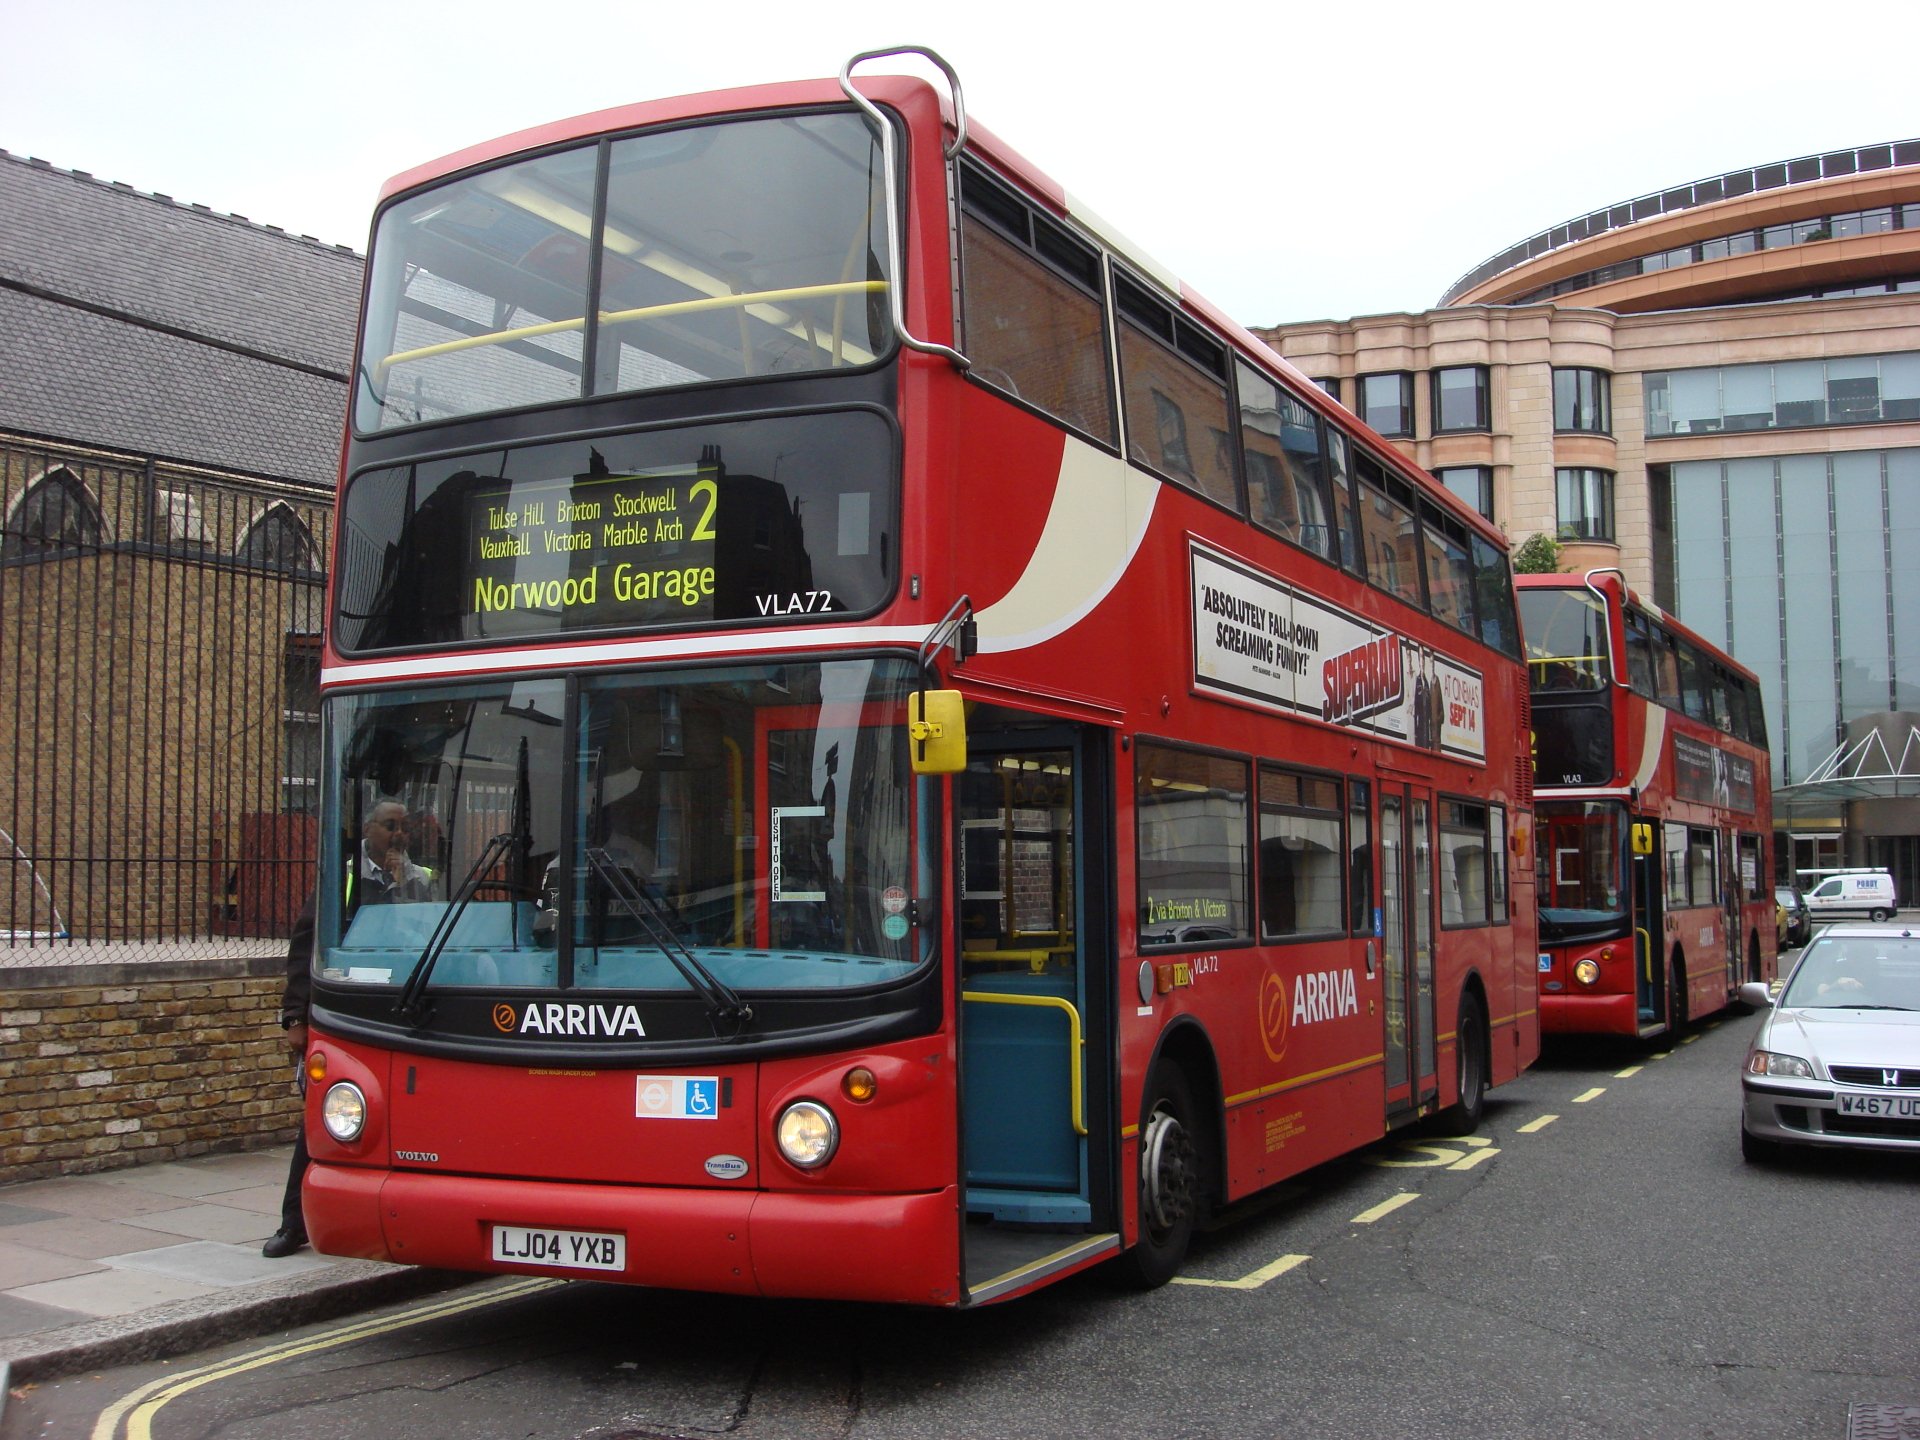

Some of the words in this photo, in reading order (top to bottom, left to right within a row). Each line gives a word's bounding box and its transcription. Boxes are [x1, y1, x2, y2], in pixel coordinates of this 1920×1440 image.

[488, 508, 518, 531] Tulse
[523, 502, 545, 526] Hill
[558, 500, 601, 524] Brixton
[613, 488, 677, 518] Stockwell
[689, 479, 718, 542] 2
[480, 531, 531, 560] Vauxhall
[544, 530, 592, 553] Victoria
[603, 523, 648, 547] Marble
[654, 516, 683, 543] Arch
[474, 566, 598, 613] Norwood
[614, 562, 715, 606] Garage
[755, 590, 832, 616] VLA72
[1216, 621, 1273, 665] SCREAMING
[1322, 632, 1401, 723] SUPERBAD
[1444, 673, 1451, 698] AT
[1453, 676, 1480, 709] CINEMAS
[1449, 702, 1467, 729] SEPT
[1468, 708, 1476, 732] 14
[1562, 774, 1582, 784] VLA3
[773, 845, 779, 863] TO
[1148, 897, 1154, 923] 2
[1156, 903, 1167, 920] via
[1168, 899, 1193, 920] Brixton
[1194, 899, 1201, 918] &
[1202, 899, 1227, 918] Victoria
[1175, 965, 1188, 984] 120
[1292, 968, 1358, 1027] ARRIVA
[520, 1003, 646, 1037] ARRIVA
[1841, 1096, 1893, 1114] W467
[395, 1150, 439, 1162] VOLVO
[707, 1161, 741, 1169] TransBus
[501, 1230, 562, 1261] LJ04
[569, 1236, 617, 1265] YXB
